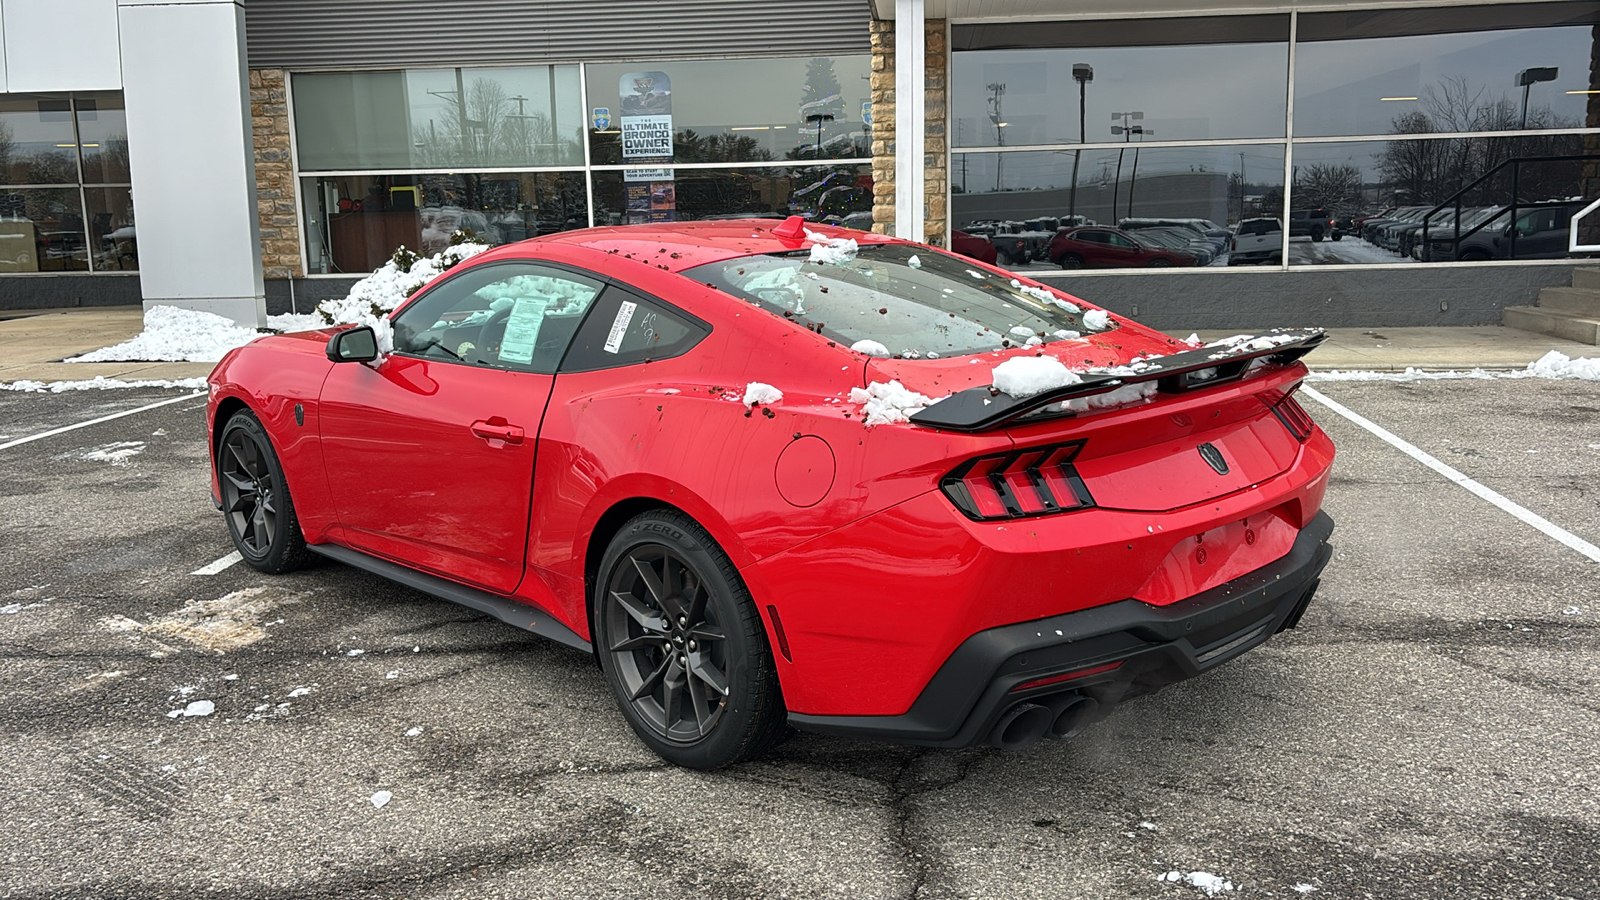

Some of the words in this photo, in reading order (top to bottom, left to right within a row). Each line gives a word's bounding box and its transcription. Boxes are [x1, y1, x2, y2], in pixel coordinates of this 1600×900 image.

[624, 131, 669, 139] BRONCO
[625, 139, 670, 148] OWNER
[642, 523, 684, 540] ZERO
